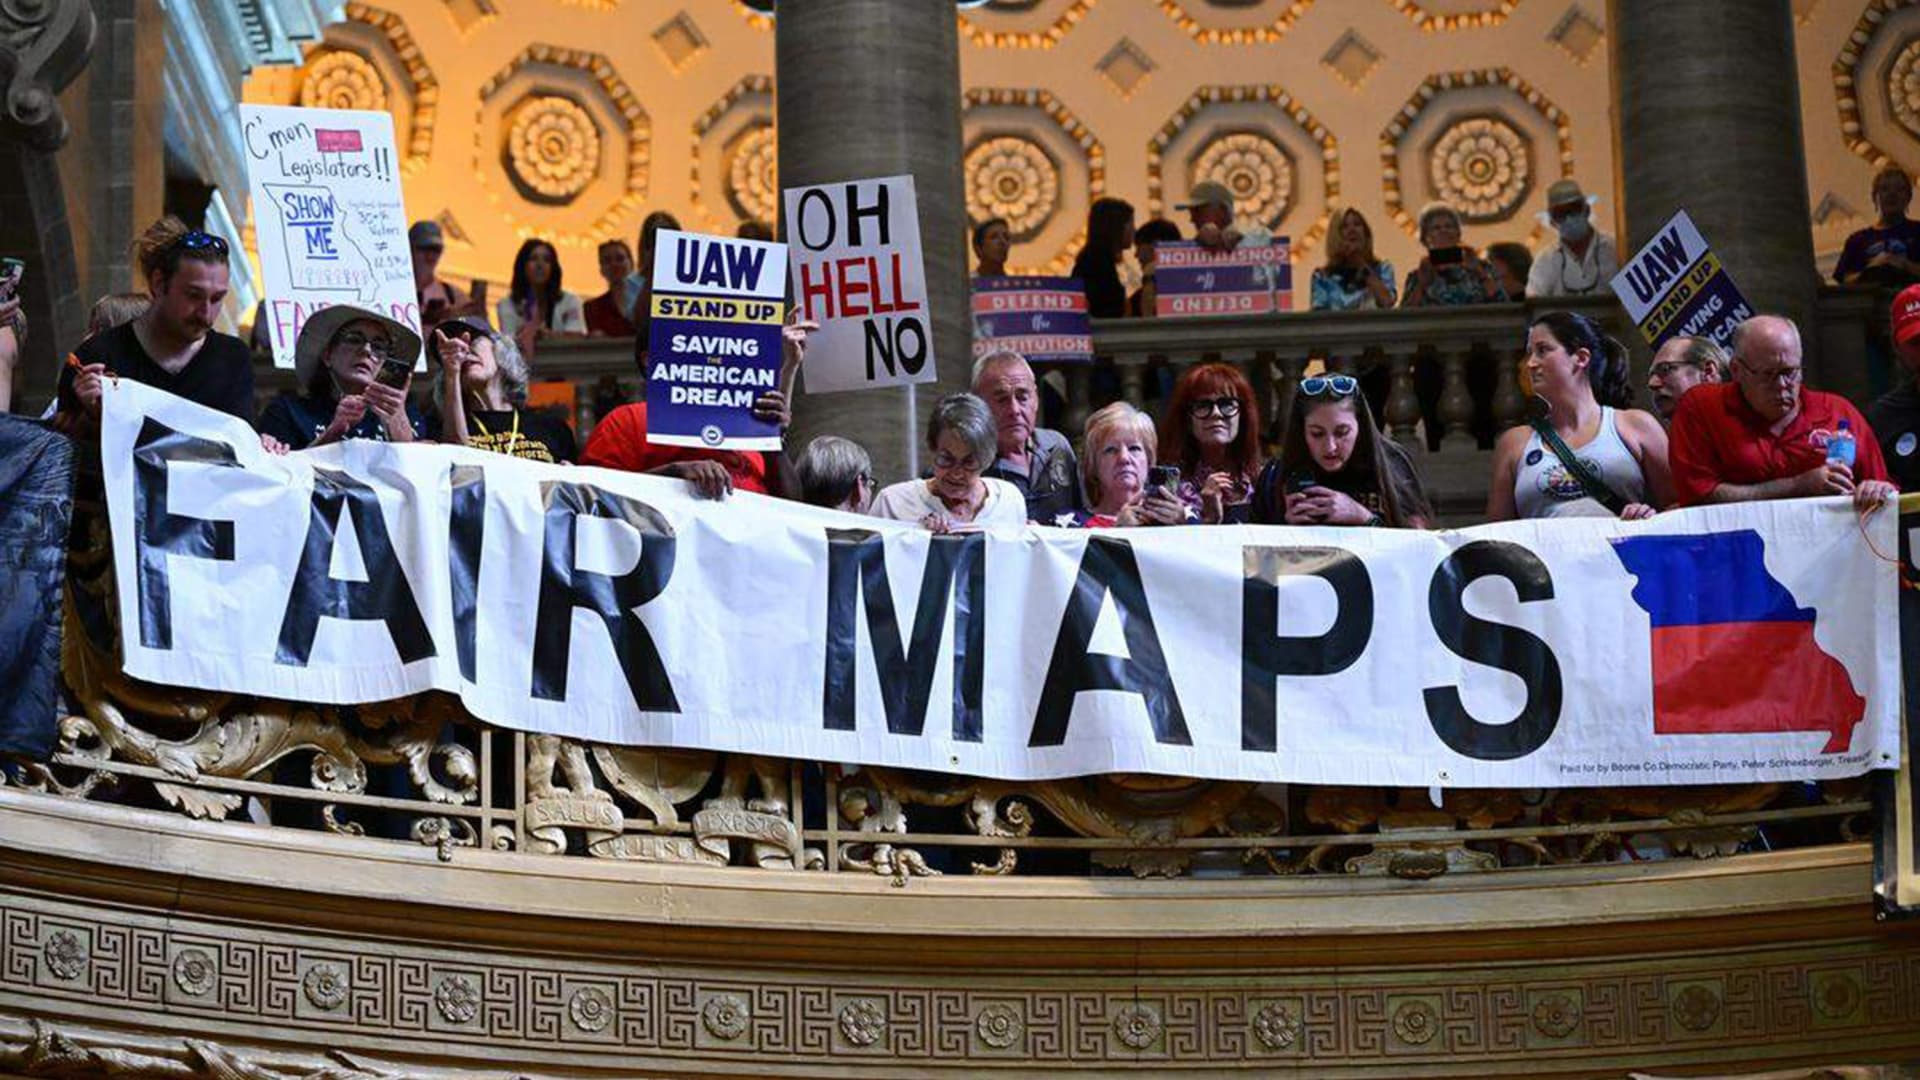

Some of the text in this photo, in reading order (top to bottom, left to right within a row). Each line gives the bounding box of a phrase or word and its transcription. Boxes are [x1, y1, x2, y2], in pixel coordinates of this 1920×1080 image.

[245, 116, 312, 160] C'mon
[283, 191, 335, 220] SHOW
[797, 184, 890, 251] OH
[305, 227, 338, 254] ME
[675, 238, 767, 291] UAW
[1625, 226, 1689, 304] UAW
[801, 253, 920, 321] HELL
[992, 294, 1073, 311] DEFEND
[1172, 296, 1253, 312] DEFEND
[1646, 261, 1713, 337] STAND UP
[272, 299, 335, 349] FA
[659, 298, 775, 321] STAND UP
[1679, 294, 1723, 337] VING
[671, 335, 759, 357] SAVING
[864, 317, 927, 380] NO
[972, 340, 1089, 356] ONSTITUTION
[652, 363, 775, 387] AMERICAN
[670, 386, 754, 408] DREAM
[133, 415, 1564, 761] FAIR MAPS
[1560, 763, 1581, 774] Paid
[1583, 762, 1595, 773] for
[1597, 763, 1609, 775] by
[1611, 761, 1640, 772] Boone
[1659, 759, 1711, 771] Democratic
[1741, 759, 1767, 769] Peter
